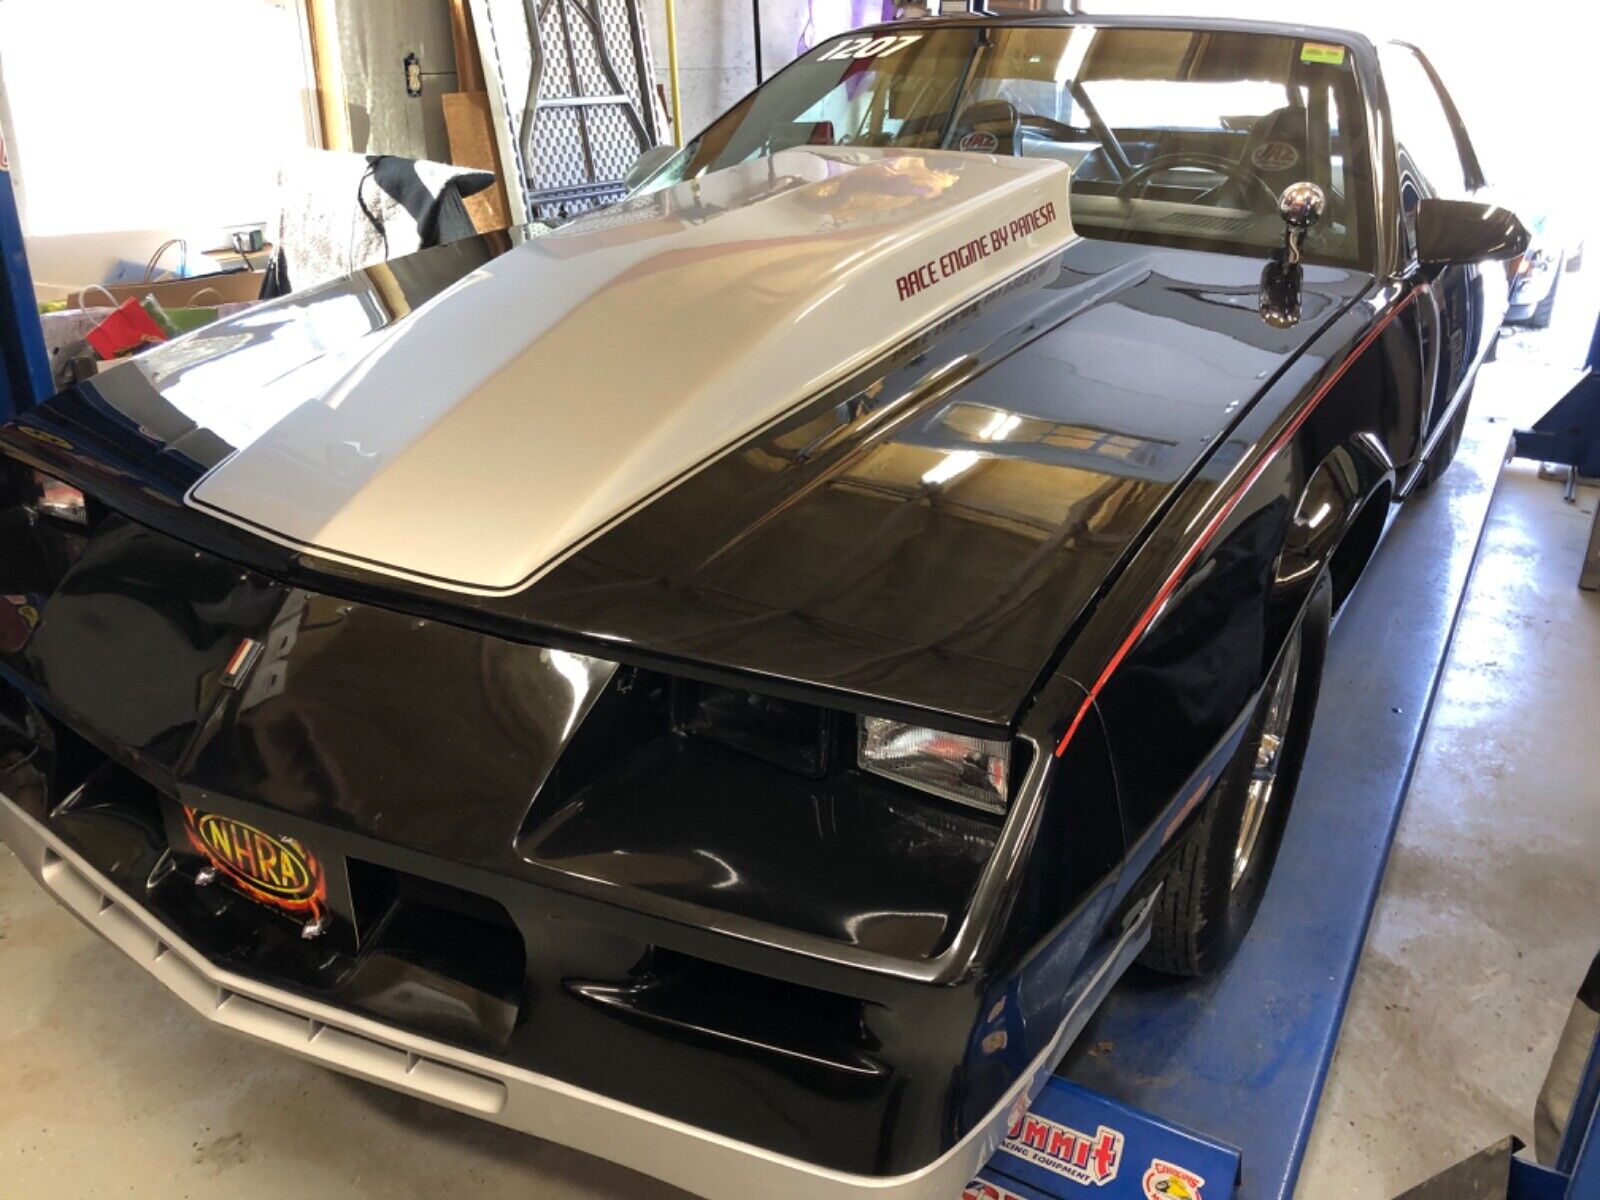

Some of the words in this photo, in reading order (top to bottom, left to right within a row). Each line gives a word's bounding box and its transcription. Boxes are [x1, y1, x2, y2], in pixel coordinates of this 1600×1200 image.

[816, 36, 923, 61] 1207
[896, 261, 940, 301] RACE
[939, 235, 990, 278] ENGINE
[990, 225, 1009, 252] BY
[208, 819, 300, 887] NHRA
[1032, 1150, 1091, 1181] EQUIPMENT
